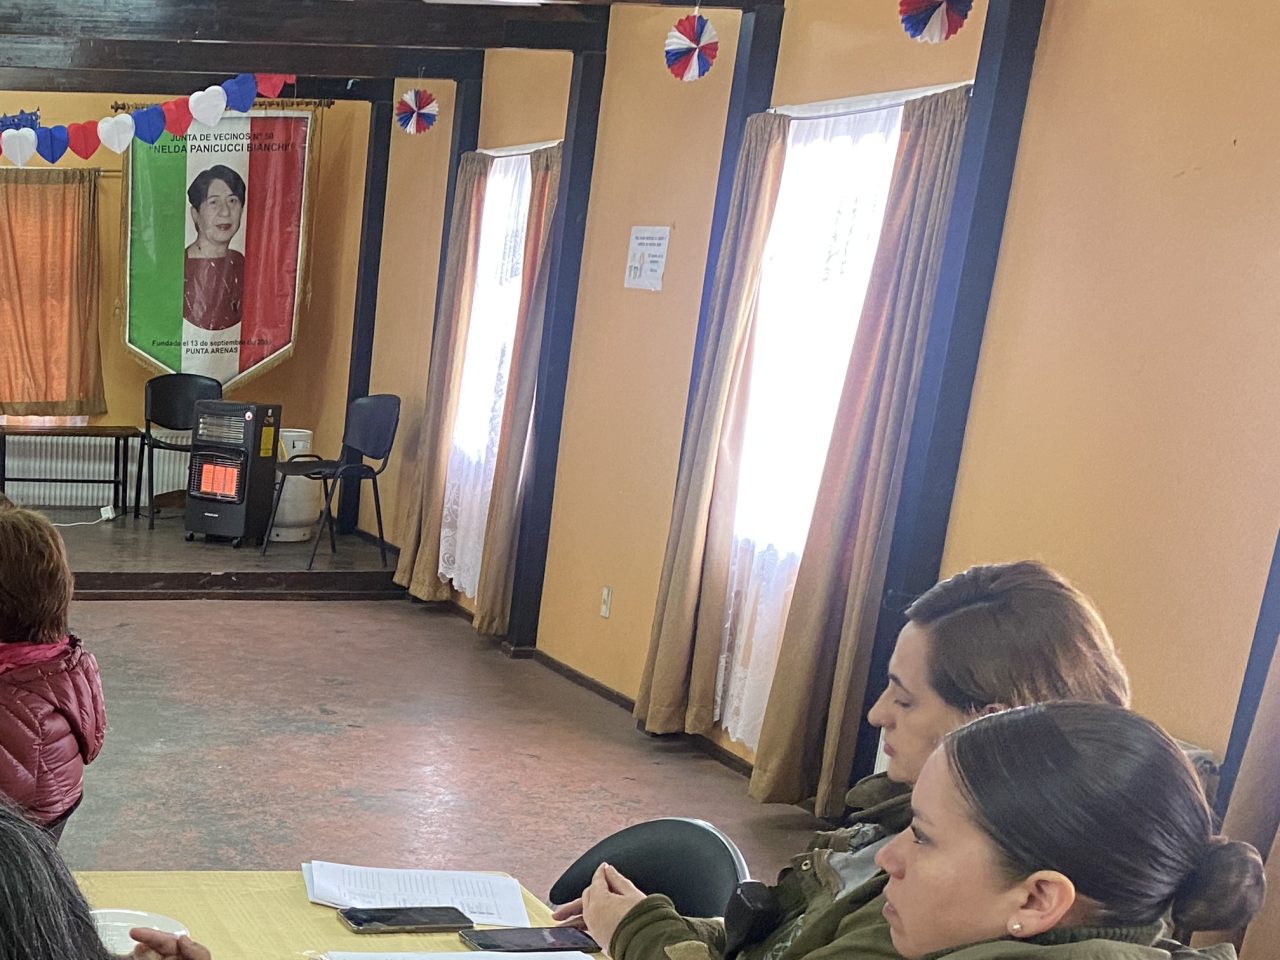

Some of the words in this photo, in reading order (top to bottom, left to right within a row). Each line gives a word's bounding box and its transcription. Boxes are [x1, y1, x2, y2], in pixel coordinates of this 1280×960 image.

[200, 133, 211, 141] DE
[213, 132, 251, 141] VECINOS
[190, 143, 244, 153] PANICUCCI
[190, 339, 198, 347] 13
[200, 339, 208, 347] de
